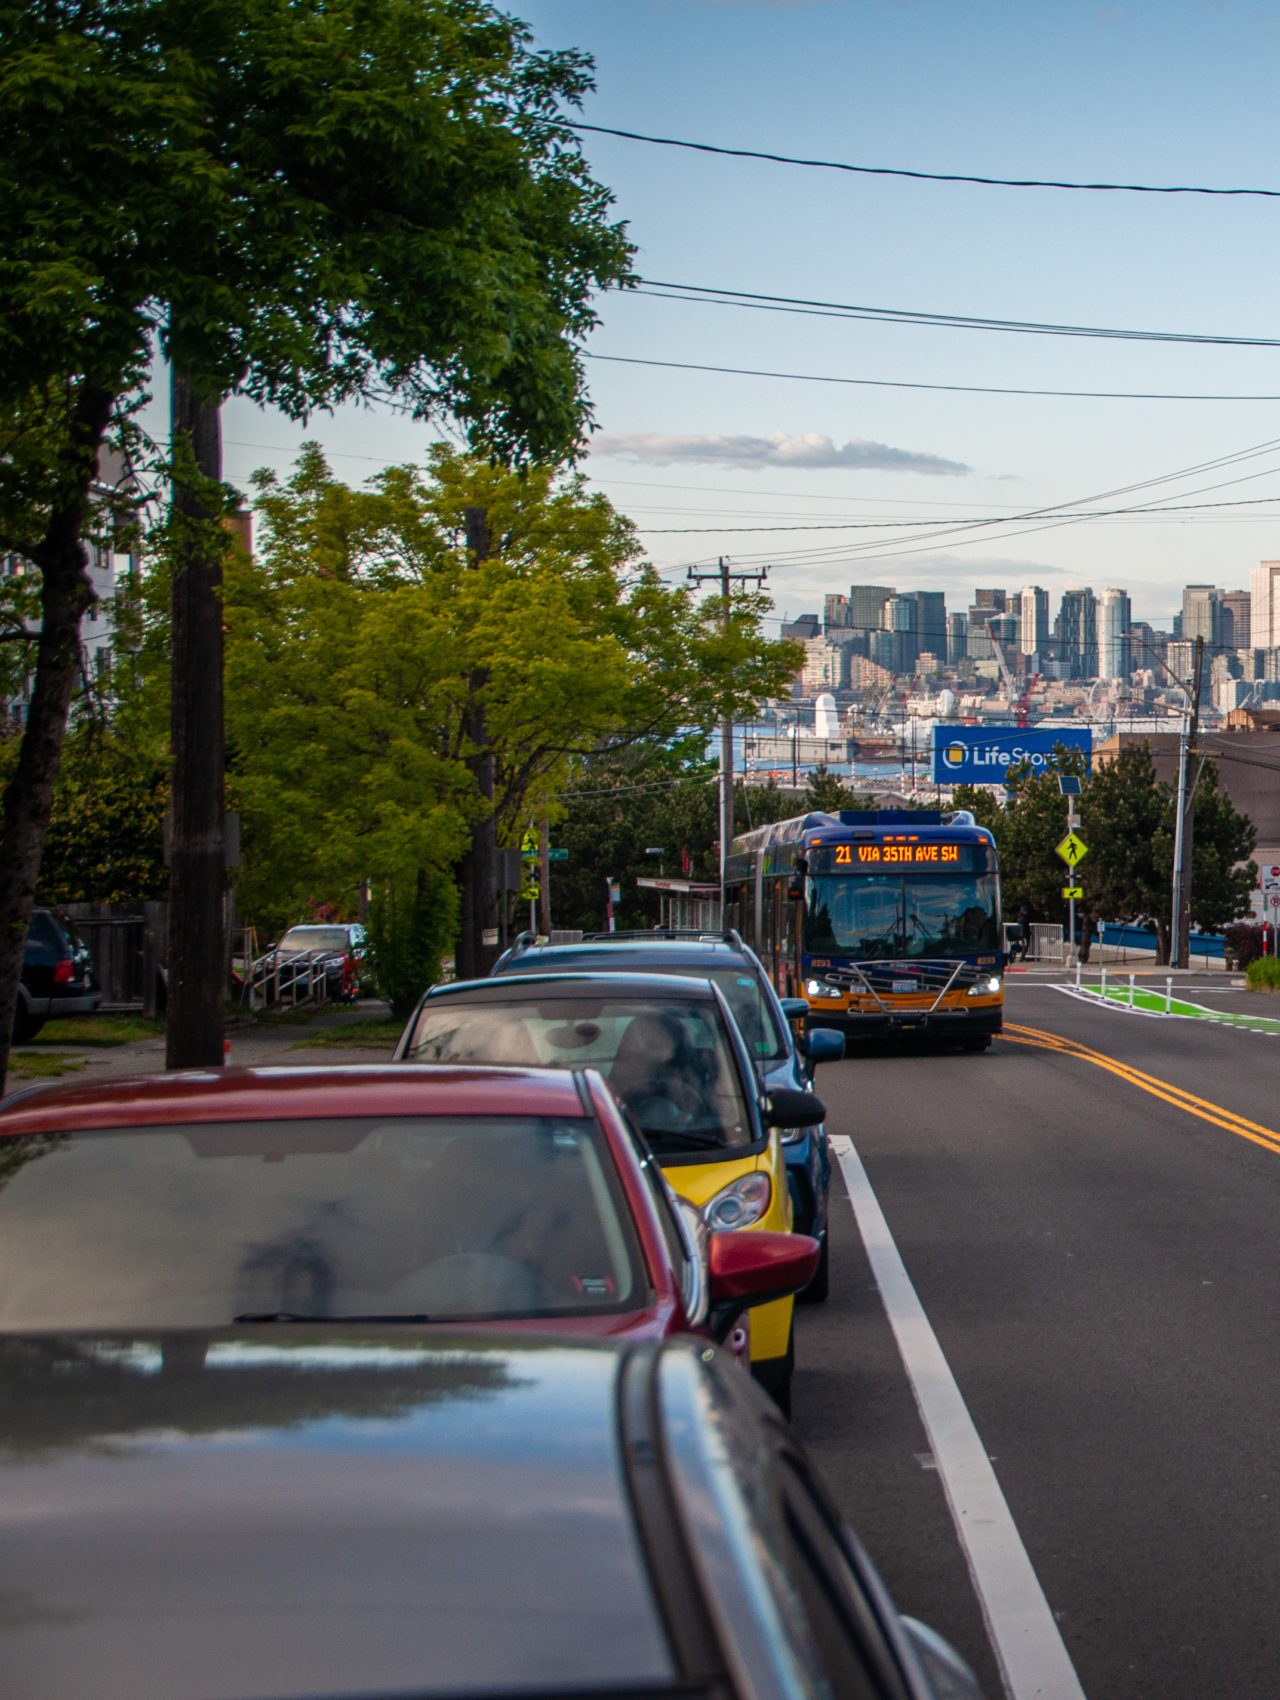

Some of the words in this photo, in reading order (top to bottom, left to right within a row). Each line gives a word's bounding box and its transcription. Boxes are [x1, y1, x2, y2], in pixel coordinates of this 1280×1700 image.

[835, 845, 852, 863] 21
[858, 846, 880, 862] VIA
[882, 846, 913, 862] 35TH
[915, 846, 938, 862] AVE
[941, 846, 958, 862] SW
